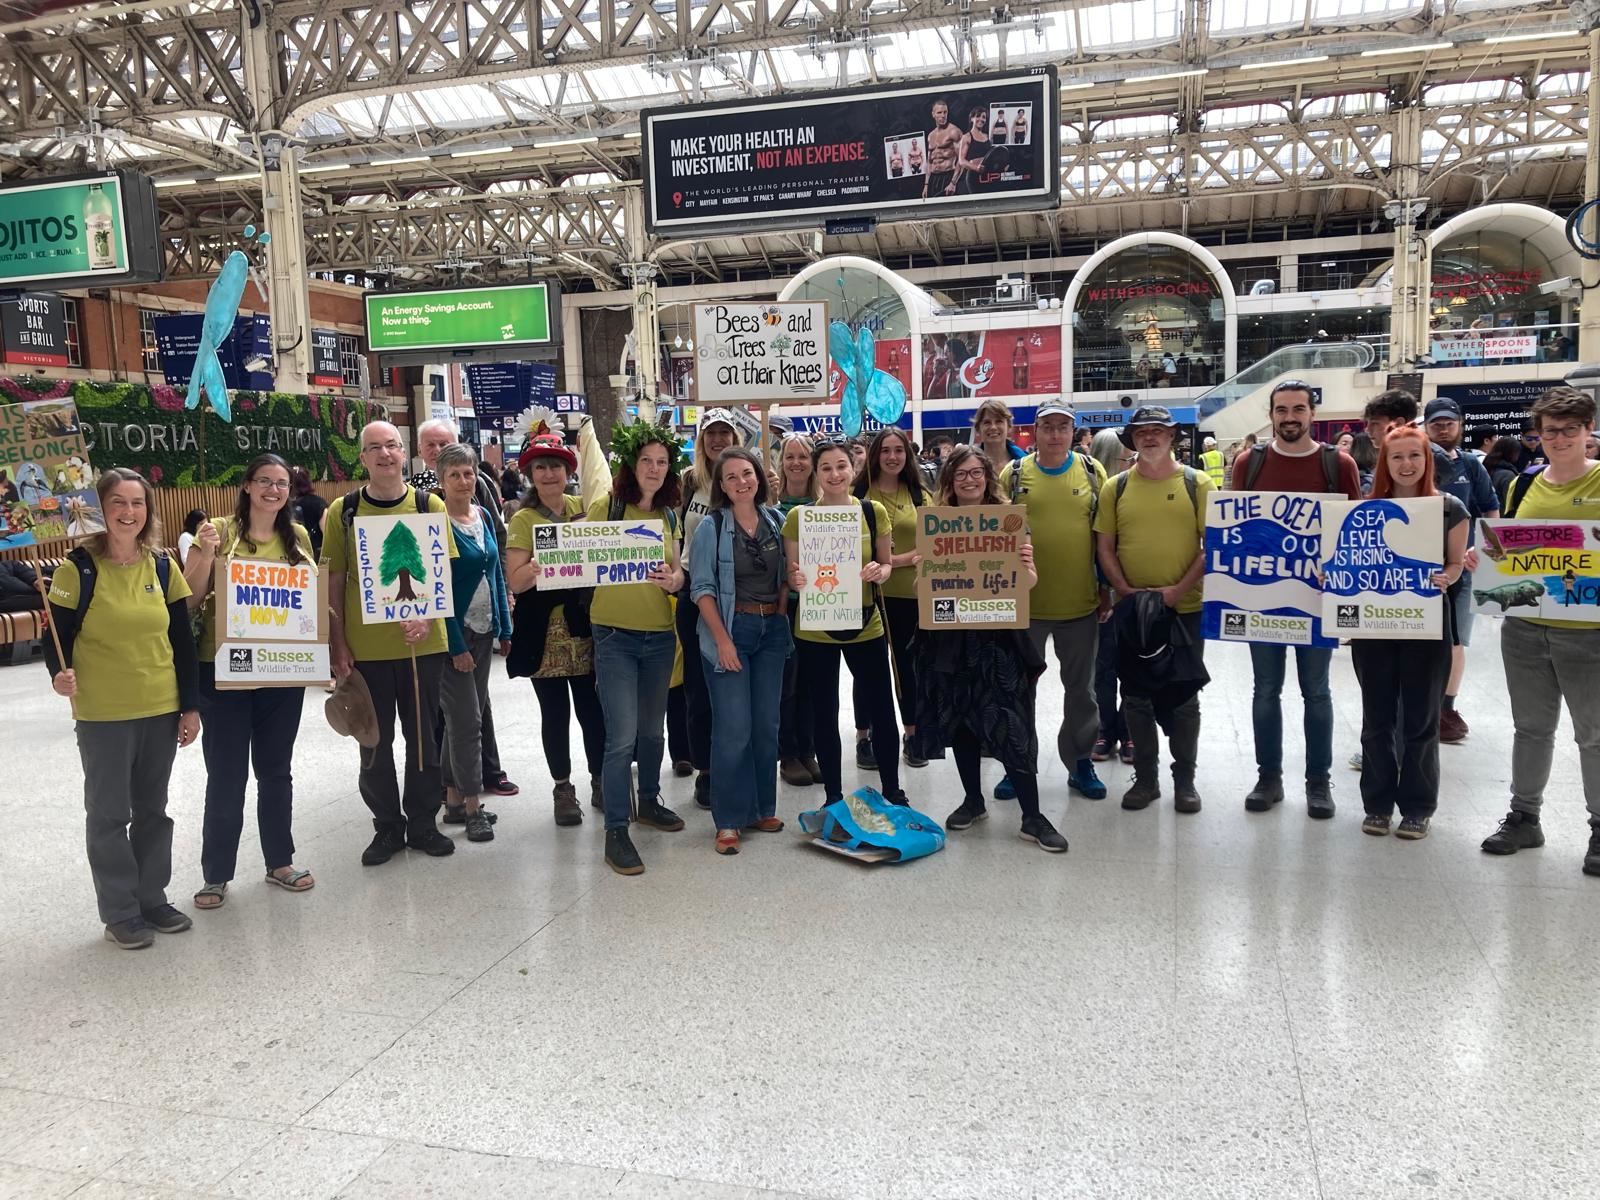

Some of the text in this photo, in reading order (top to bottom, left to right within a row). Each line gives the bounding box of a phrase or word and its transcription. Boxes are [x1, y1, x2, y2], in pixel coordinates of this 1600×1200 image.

[670, 126, 815, 157] MAKE YOUR HEALTH AN
[672, 141, 869, 177] INVESTMENT, NOT AN EXPENSE.
[703, 186, 739, 195] WORLD'S
[742, 183, 778, 192] LEADING
[781, 179, 825, 189] PERSONAL
[829, 175, 870, 184] TRAINERS
[685, 200, 695, 208] CITY
[700, 198, 718, 207] MAYFAIR
[722, 196, 749, 205] KENSINGTON
[778, 191, 796, 200] CANARY
[796, 190, 812, 199] WHARF
[816, 188, 837, 197] CHELSEA
[841, 185, 869, 195] PADDINGTON
[831, 225, 864, 234] JCDecaux
[57, 248, 72, 256] RUM
[1088, 281, 1211, 301] WETHERSPOONS
[18, 298, 49, 314] SPORTS
[381, 301, 494, 316] An Energy Savings Account.
[26, 315, 44, 330] BAR
[382, 317, 401, 326] Now
[408, 316, 432, 326] thing.
[716, 305, 812, 334] Bees and
[31, 331, 54, 347] GRILL
[318, 336, 337, 348] SPORTS
[724, 334, 817, 358] Trees are
[1441, 338, 1531, 350] WETHERSPOONS
[23, 355, 52, 363] VICTORIA
[323, 349, 334, 359] BAR
[1474, 348, 1524, 357] RESTAURANT
[326, 361, 339, 372] GRILL
[717, 359, 823, 385] on their knees
[1499, 387, 1523, 395] YARD
[2, 404, 25, 425] IS
[1081, 414, 1123, 424] NERO
[1465, 412, 1508, 421] Passenger
[802, 416, 886, 433] WHit
[1500, 422, 1521, 430] Point
[0, 425, 26, 445] RE
[235, 425, 322, 451] STATION
[0, 436, 82, 465] BELONG!
[1214, 495, 1262, 520] THE
[804, 510, 858, 522] Sussex
[1352, 510, 1386, 528] SEA
[561, 524, 621, 538] Sussex
[804, 524, 858, 533] Wildlife Trust
[924, 513, 998, 536] Don't be
[1222, 527, 1243, 545] IS
[1340, 530, 1386, 547] LEVEL
[1502, 527, 1573, 543] RESTORE
[563, 538, 621, 549] Wildlife Trust
[802, 538, 825, 551] WHY
[932, 536, 1017, 557] SHELLFISH
[538, 545, 664, 565] NATURE RESTORATION
[802, 550, 856, 566] YOU GIVE A
[1334, 547, 1394, 566] IS RISING
[1512, 554, 1592, 572] NATURE
[231, 562, 310, 589] RESTORE
[359, 527, 376, 614] RESTORE
[428, 525, 447, 610] NATURE
[544, 561, 664, 584] IS OUR PORPOIS
[931, 574, 974, 591] marine
[1322, 570, 1353, 590] AND
[1358, 570, 1379, 590] SO
[1382, 568, 1415, 590] ARE
[236, 585, 303, 610] NATURE
[806, 591, 849, 606] HOOT
[1564, 584, 1600, 607] NO
[385, 603, 428, 619] NOW
[958, 598, 1015, 612] Sussex
[1363, 604, 1424, 618] Sussex
[250, 606, 289, 626] NOW
[801, 609, 828, 620] ABOUT
[960, 613, 991, 621] Wildlife
[993, 613, 1015, 621] Trust
[1250, 614, 1307, 630] Sussex
[1364, 620, 1425, 630] Wildlife Trust
[1250, 629, 1283, 638] Wildlife
[1284, 631, 1307, 641] Trust
[256, 648, 314, 662] Sussex
[257, 664, 315, 673] Wildlife Trust
